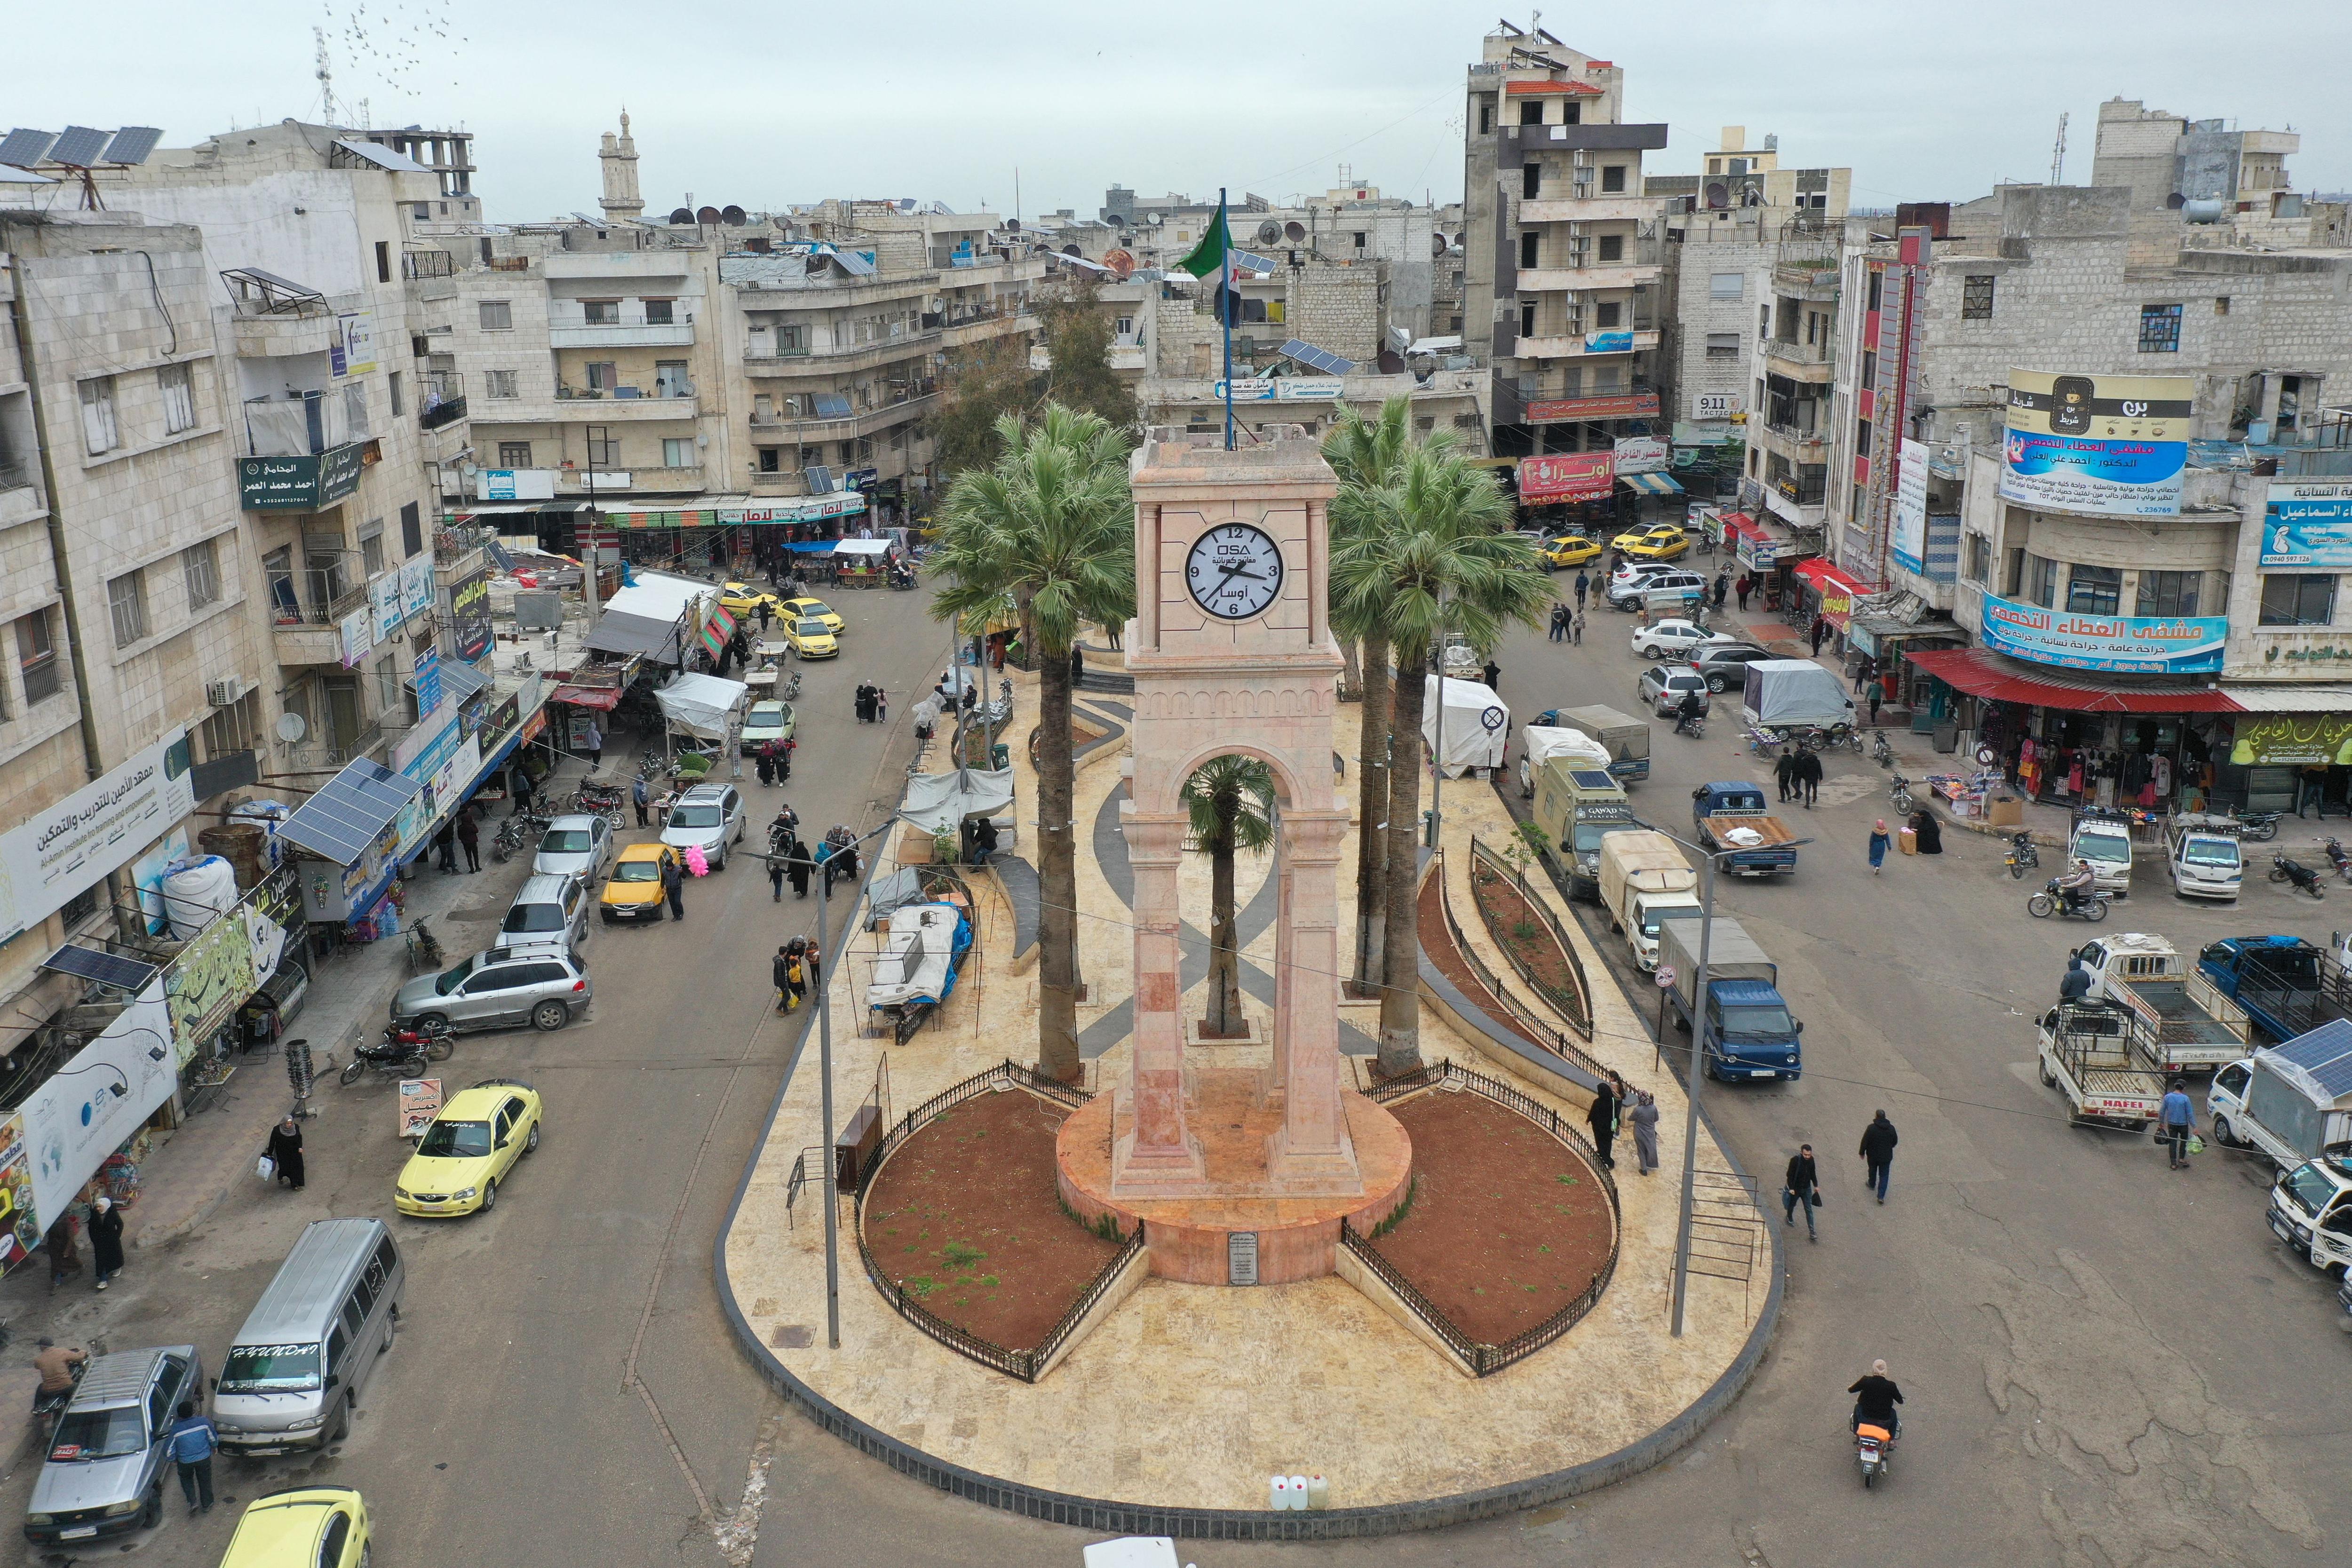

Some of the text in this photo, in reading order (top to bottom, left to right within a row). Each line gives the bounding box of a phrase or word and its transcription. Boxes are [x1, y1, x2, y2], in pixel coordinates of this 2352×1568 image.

[1612, 399, 1632, 407] الدكتور
[1634, 395, 1659, 412] مخبر
[1700, 398, 1725, 409] 9.11
[2013, 390, 2033, 408] شريط
[2122, 400, 2148, 418] بن
[2059, 413, 2079, 425] شريط
[1615, 447, 1665, 462] القصور الفاخرة
[2025, 439, 2156, 455] مشفى العطاء التخصصي
[337, 452, 350, 469] المحامي
[2029, 453, 2137, 468] الدكتور أحمد علي العلي
[263, 463, 296, 475] المحامي
[348, 462, 358, 478] أحمد
[1553, 456, 1611, 483] أوبرا
[295, 478, 315, 489] أحمد
[336, 471, 347, 483] محمد
[245, 481, 266, 492] العمر
[2294, 486, 2338, 500] النسائية
[742, 509, 772, 524] لامار
[821, 501, 842, 517] لامار
[2280, 505, 2341, 520] السماعيل
[1227, 527, 1243, 538] 12
[2308, 537, 2330, 546] السوري
[1217, 545, 1250, 555] OSA
[1212, 557, 1237, 565] كهربائية
[1190, 567, 1199, 577] 9
[1269, 566, 1278, 576] 3
[453, 576, 486, 619] مركز العاصي
[1220, 585, 1248, 601] أوسا
[1229, 604, 1238, 614] 6
[1990, 605, 2202, 640] مشفى العطاء التخصصي
[1997, 625, 2166, 655] جراحة عامة جراحة نسائية جراحة بولية
[1994, 641, 2164, 673] ولادة بدون ألم حواضن عناية أطفال مخبر
[2246, 714, 2292, 749] العاصي
[134, 765, 153, 787] معهد
[111, 776, 133, 805] الأمين
[79, 791, 110, 824] للتدريب
[38, 815, 78, 852] والتمكين
[41, 849, 64, 869] Al-Amin
[64, 834, 87, 855] Institute
[96, 816, 114, 833] training
[115, 810, 124, 821] and
[125, 787, 155, 814] empowerment
[271, 868, 295, 904] صالون
[404, 1103, 437, 1114] جميل
[2103, 1098, 2144, 1107] HAFEI
[233, 1345, 319, 1358] HYUNDAI
